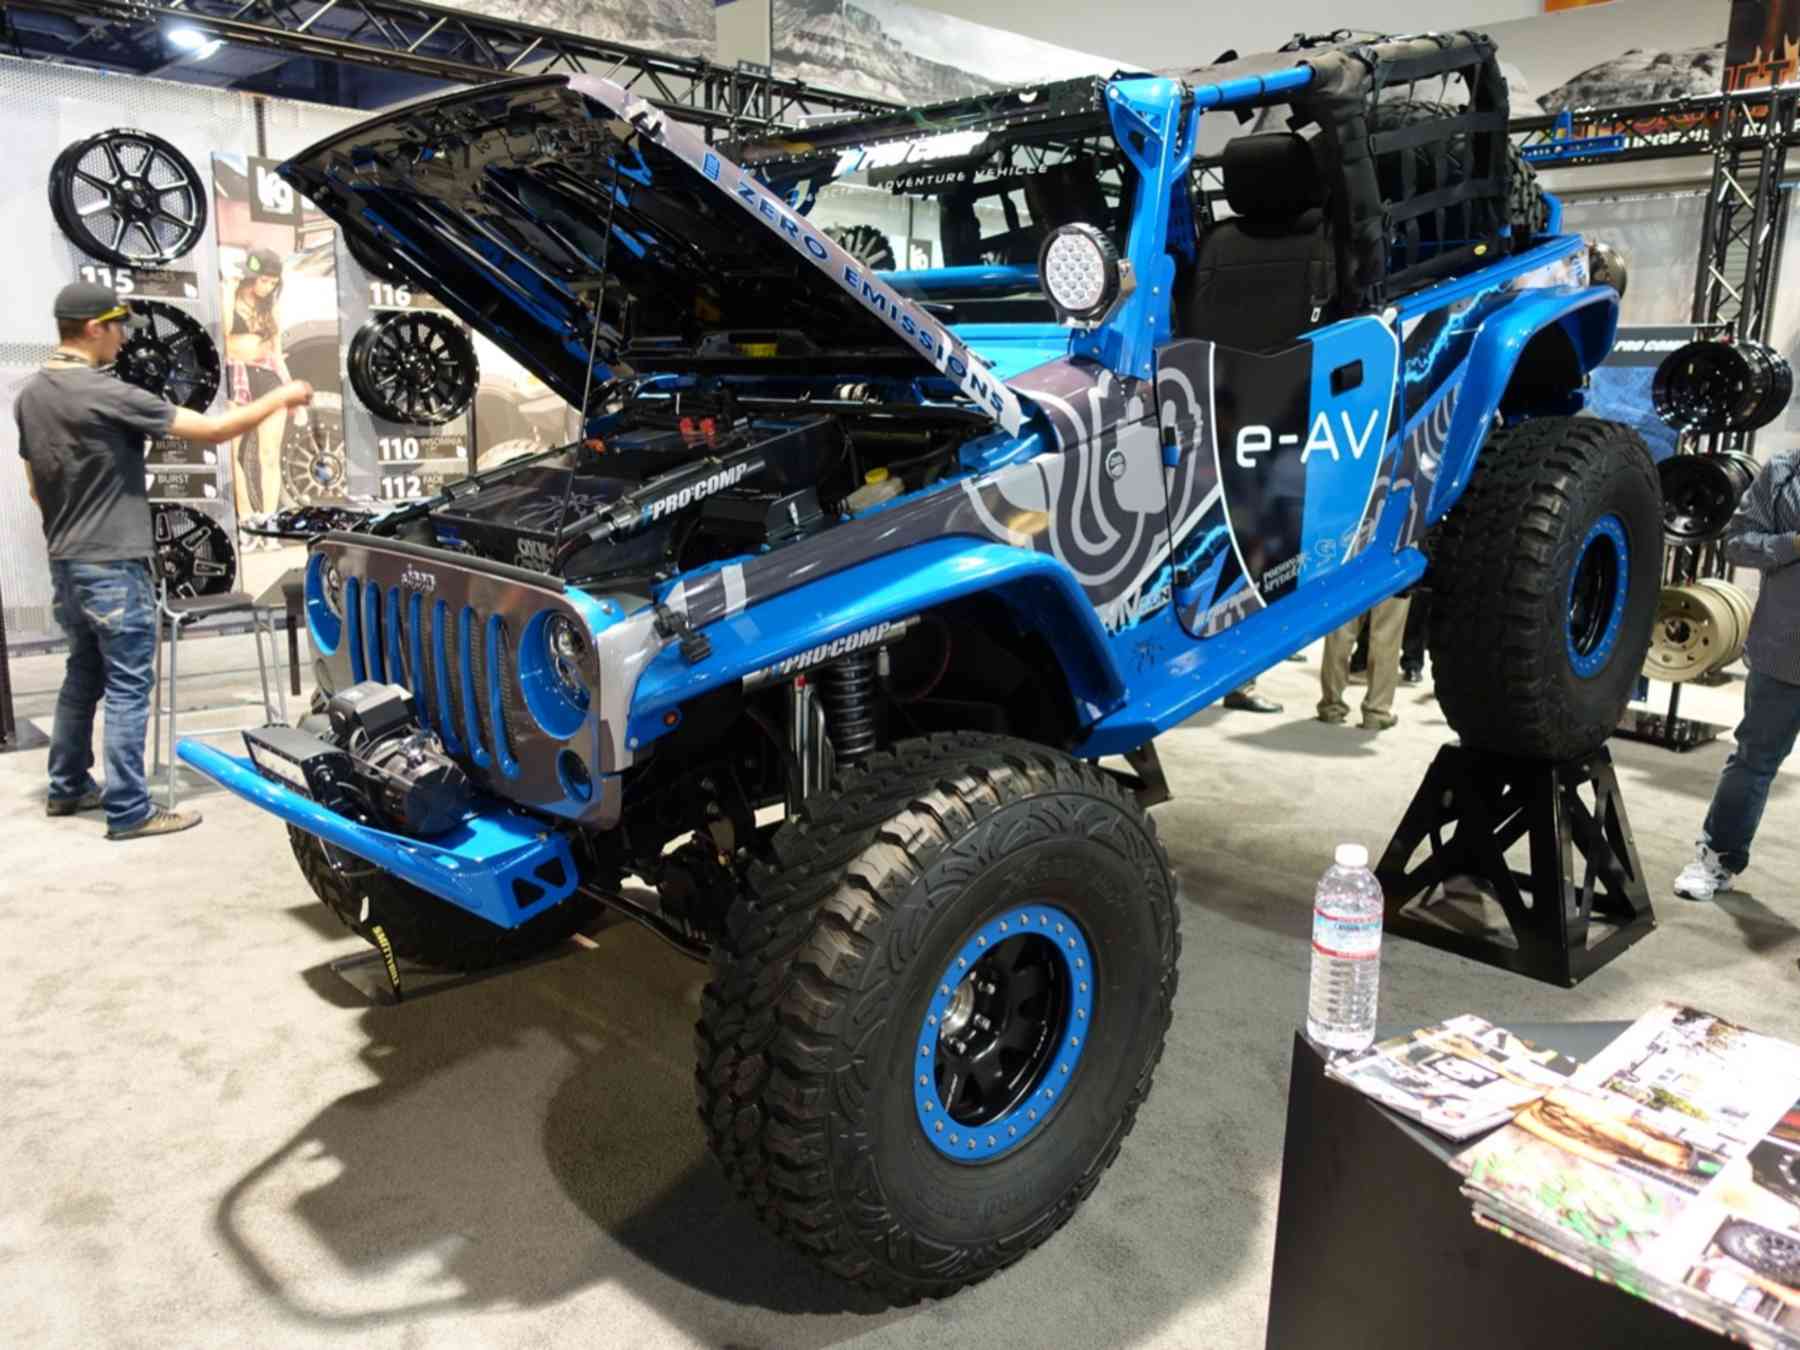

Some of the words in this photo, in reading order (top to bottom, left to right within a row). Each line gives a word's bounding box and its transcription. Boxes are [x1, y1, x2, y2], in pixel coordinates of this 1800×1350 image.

[876, 171, 966, 191] ADVENTURE
[974, 164, 1049, 183] VEHICLE
[81, 265, 135, 294] 115
[370, 281, 412, 308] 116
[736, 180, 829, 260] ZERO
[844, 265, 1005, 414] EMISSIONS
[378, 437, 419, 460] 110
[1236, 408, 1380, 468] e-AV
[382, 475, 422, 498] 112
[652, 487, 692, 520] PRO
[693, 462, 748, 501] COMP
[829, 621, 891, 658] COMP
